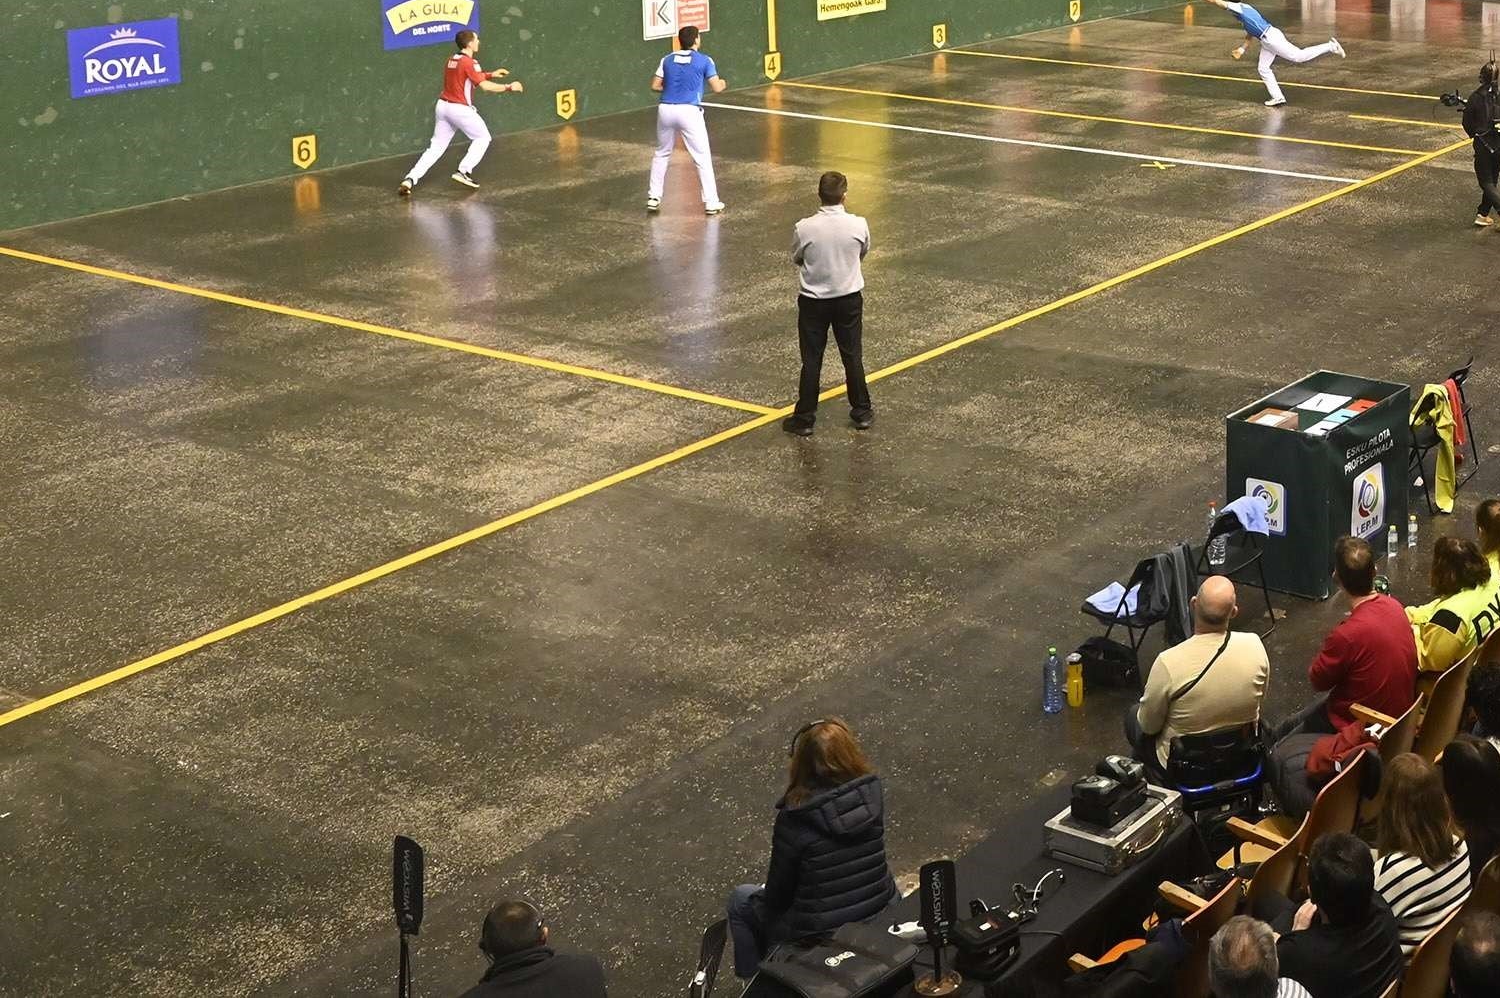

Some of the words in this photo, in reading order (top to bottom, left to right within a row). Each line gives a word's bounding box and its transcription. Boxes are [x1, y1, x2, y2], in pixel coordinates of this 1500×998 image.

[399, 9, 417, 23] LA
[423, 2, 459, 16] GULA
[1072, 2, 1079, 17] 2
[413, 28, 427, 36] DEL
[427, 24, 451, 35] NORTE
[936, 27, 943, 43] 3
[85, 53, 167, 84] ROYAL
[767, 57, 777, 73] 4
[561, 93, 572, 114] 5
[297, 140, 311, 163] 6
[1346, 442, 1367, 460] ESKU
[1368, 428, 1391, 449] PILOTA
[1344, 439, 1394, 476] PROFESIONALA
